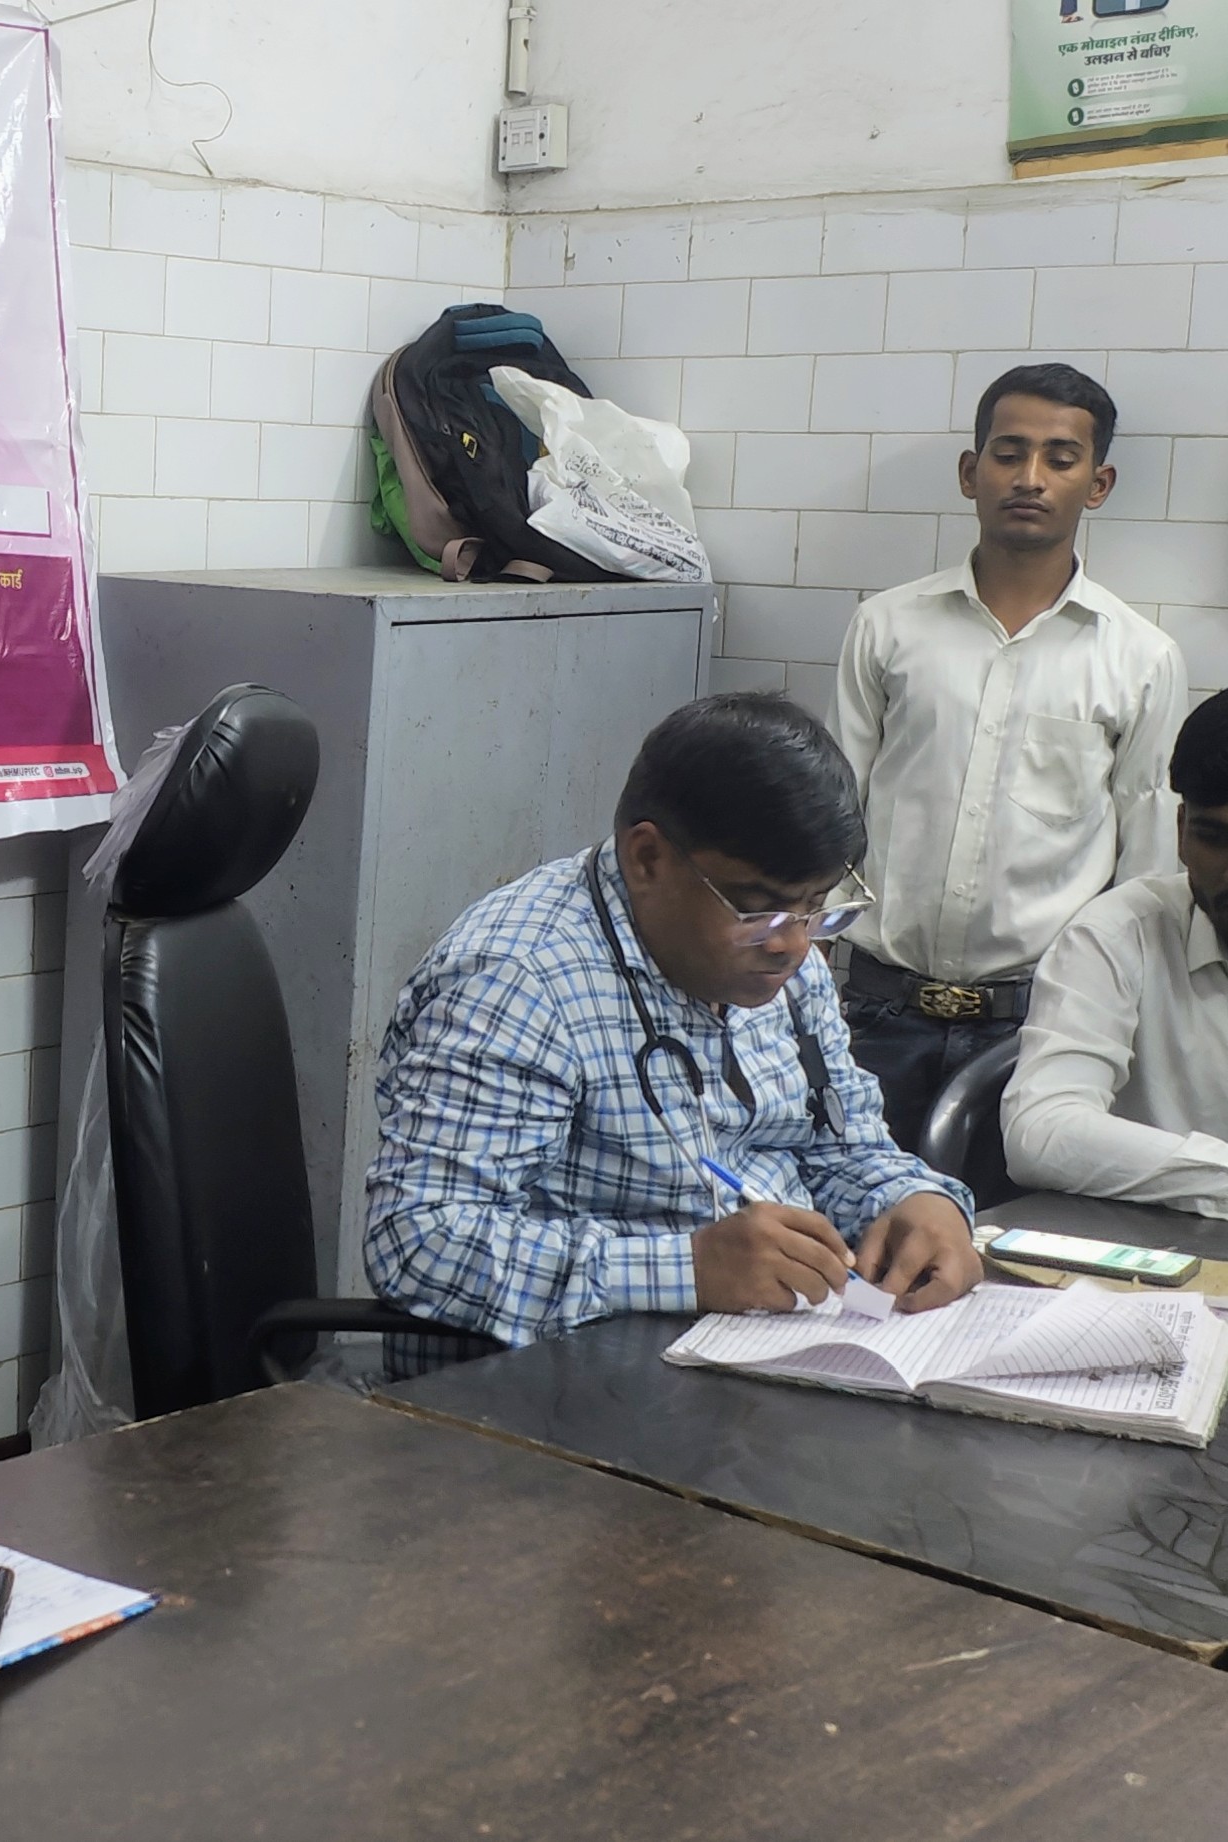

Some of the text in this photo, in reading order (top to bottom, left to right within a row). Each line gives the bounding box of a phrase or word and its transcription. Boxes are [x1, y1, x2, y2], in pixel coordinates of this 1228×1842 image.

[1058, 42, 1078, 56] एक
[1158, 25, 1199, 42] दीजिए,
[1084, 51, 1125, 66] उलझन
[1126, 46, 1138, 60] से
[0, 568, 24, 590] कार्ड
